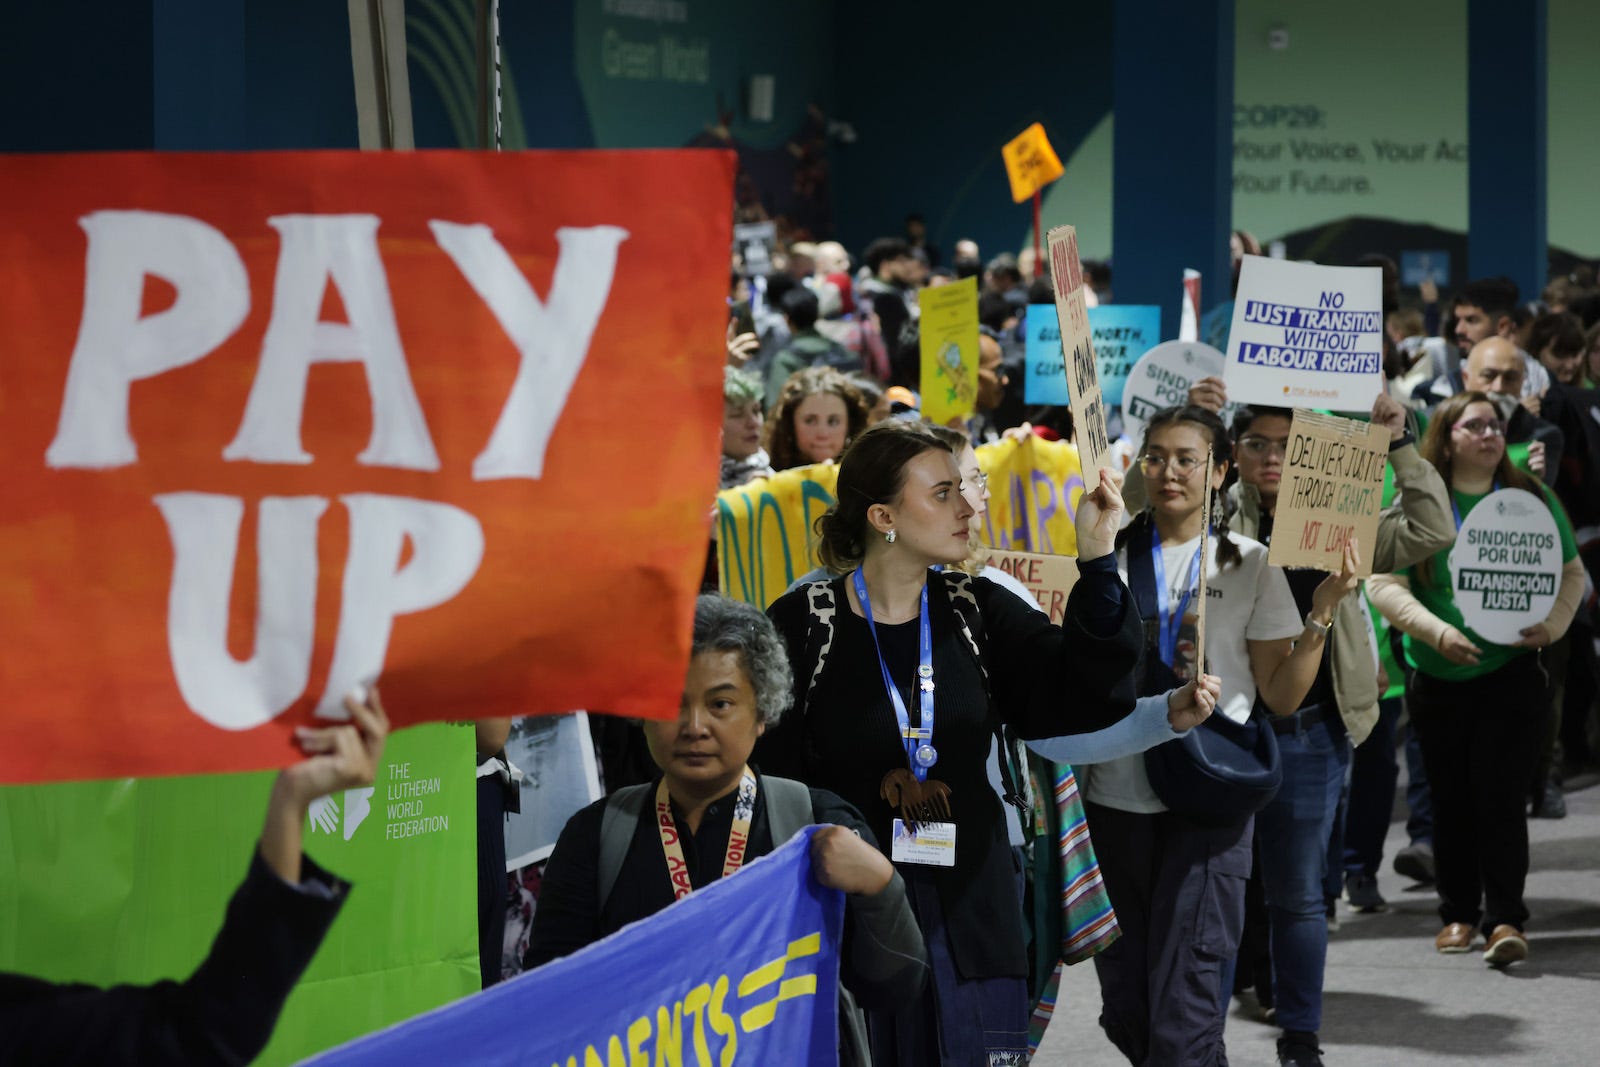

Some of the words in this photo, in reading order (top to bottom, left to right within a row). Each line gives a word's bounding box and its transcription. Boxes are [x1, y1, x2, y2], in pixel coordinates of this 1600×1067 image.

[1289, 138, 1364, 164] Voice,
[1371, 139, 1427, 163] Your
[1318, 291, 1345, 309] NO
[1245, 302, 1295, 326] JUST
[1298, 308, 1380, 332] TRANSITION
[46, 209, 630, 479] PAY
[1284, 329, 1359, 350] WITHOUT
[1243, 344, 1317, 370] LABOUR
[1320, 352, 1377, 372] RIGHTS!
[1290, 434, 1346, 478] DELIVER
[1290, 475, 1336, 509] THROUGH
[1336, 483, 1375, 516] GRANTS
[1299, 520, 1323, 550] NOT
[1467, 529, 1554, 549] SINDICATOS
[1478, 547, 1508, 564] POR
[1512, 549, 1542, 566] UNA
[1461, 572, 1553, 594] TRANSICIÓN
[152, 492, 485, 731] UP
[1485, 590, 1529, 609] JUSTA
[387, 762, 411, 780] THE
[387, 777, 441, 801] LUTHERAN
[387, 799, 424, 820] WORLD
[386, 815, 449, 841] FEDERATION
